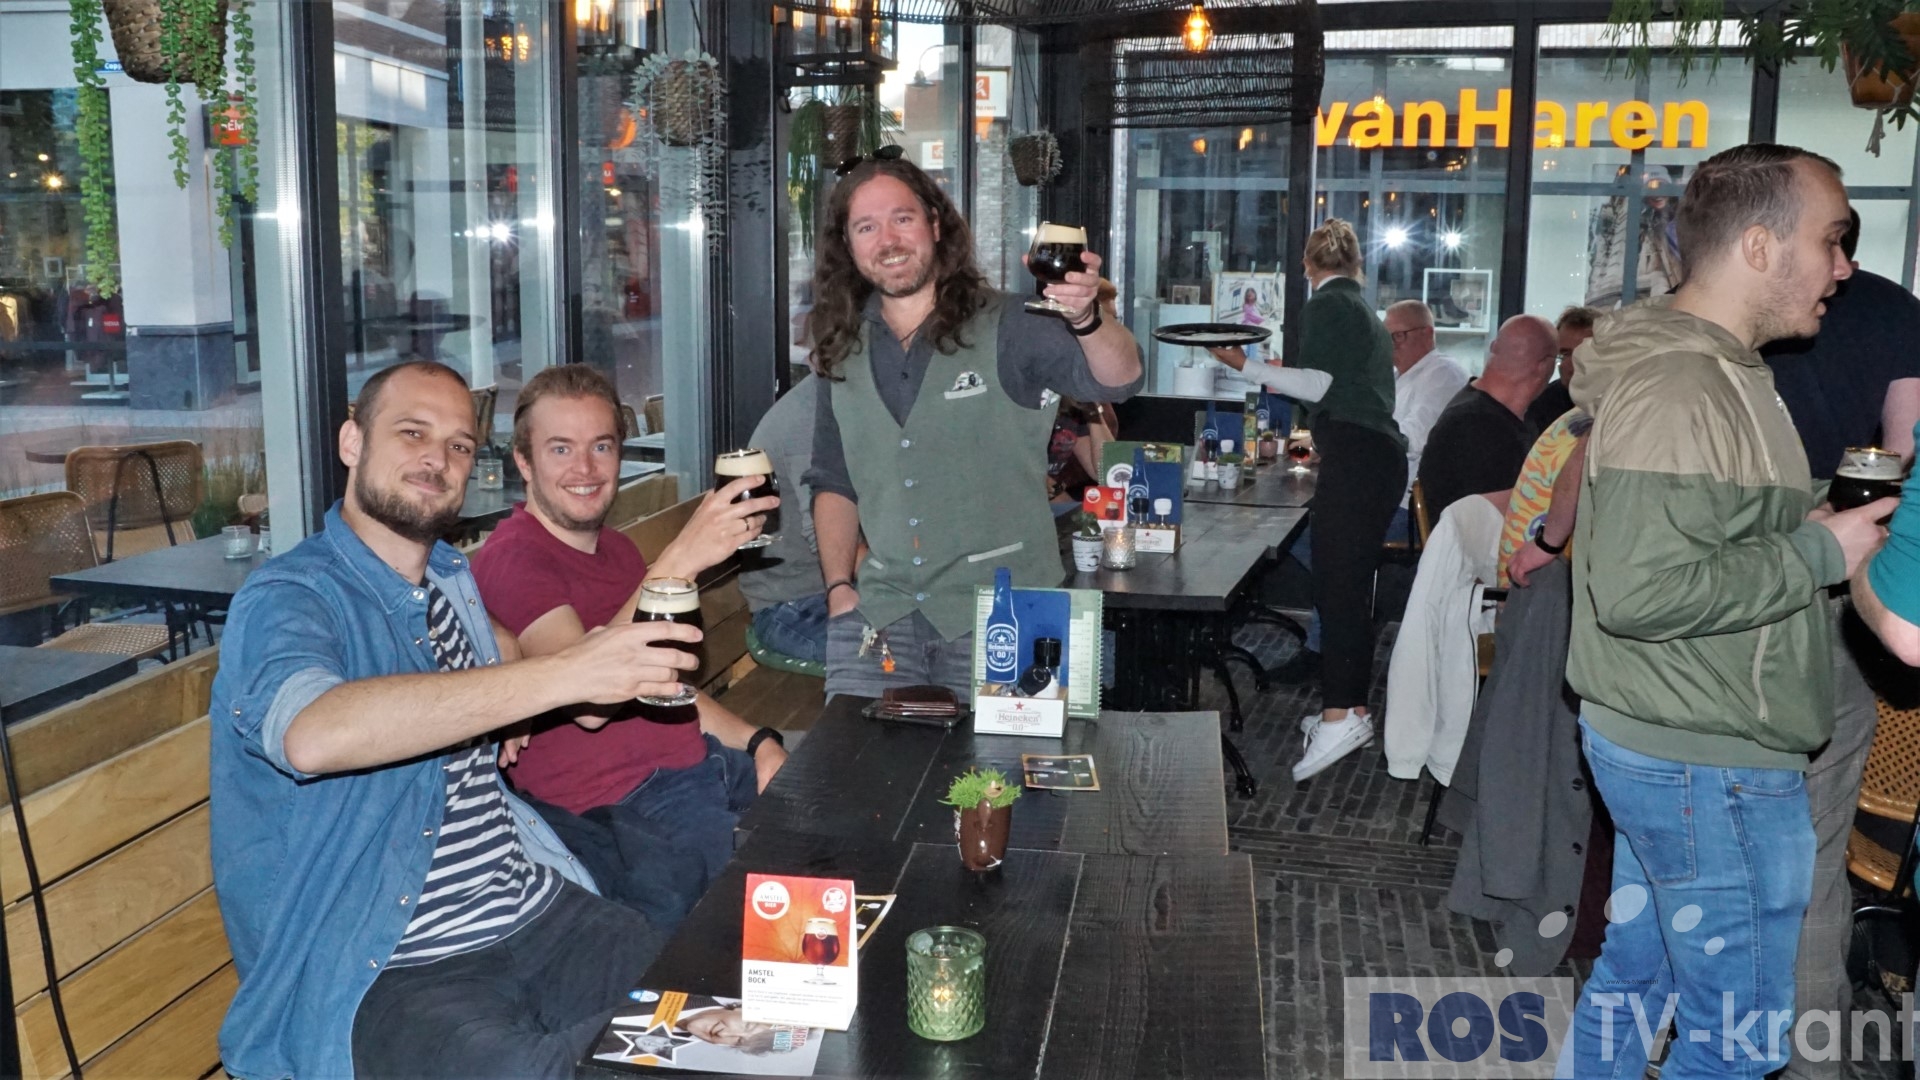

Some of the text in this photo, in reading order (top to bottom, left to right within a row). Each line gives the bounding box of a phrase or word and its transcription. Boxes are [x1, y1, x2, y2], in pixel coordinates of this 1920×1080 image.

[1317, 87, 1709, 150] vanHaren
[998, 711, 1041, 724] Heineken
[748, 968, 774, 978] AMSTEL
[747, 976, 767, 984] BOCK
